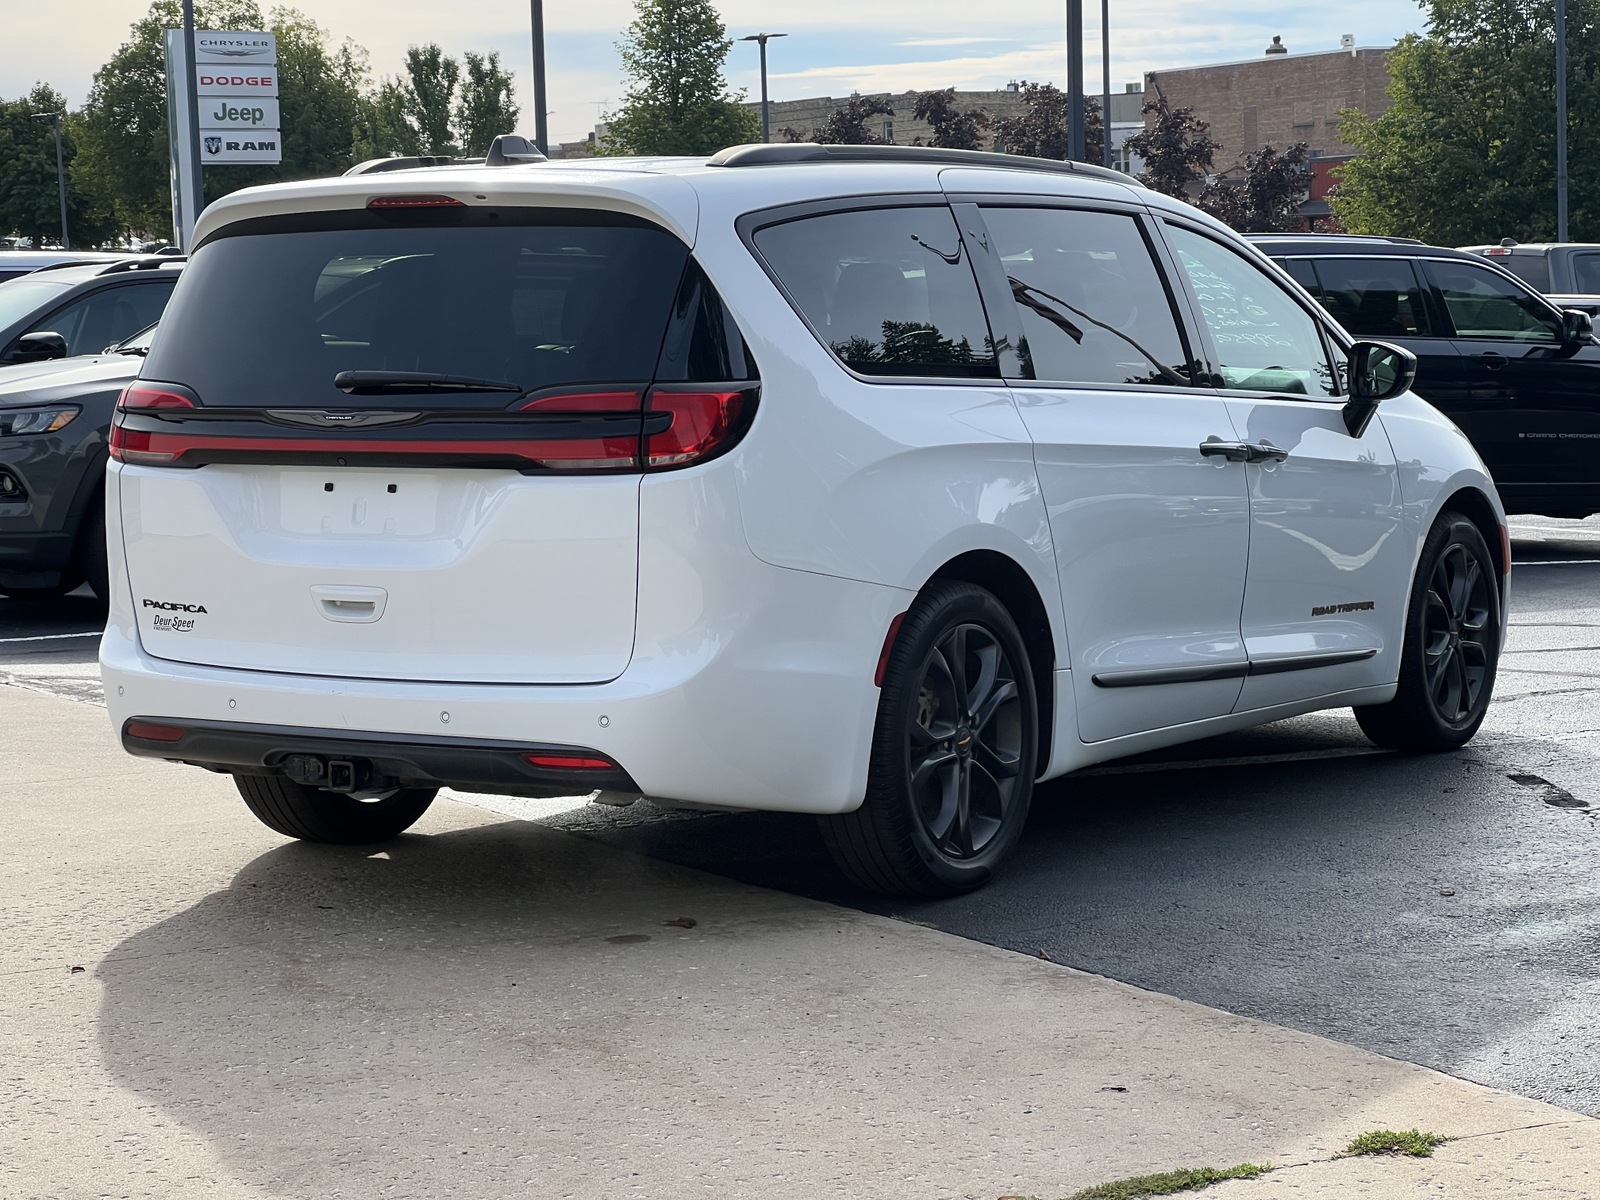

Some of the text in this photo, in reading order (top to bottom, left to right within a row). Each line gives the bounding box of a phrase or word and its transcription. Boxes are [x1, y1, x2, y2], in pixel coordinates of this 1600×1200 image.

[200, 39, 269, 47] CHRYSLER
[200, 76, 273, 86] DODGE
[213, 102, 264, 125] Jeep
[226, 141, 276, 151] RAM
[142, 598, 208, 614] PACIFICA
[154, 614, 195, 630] Deur Speet
